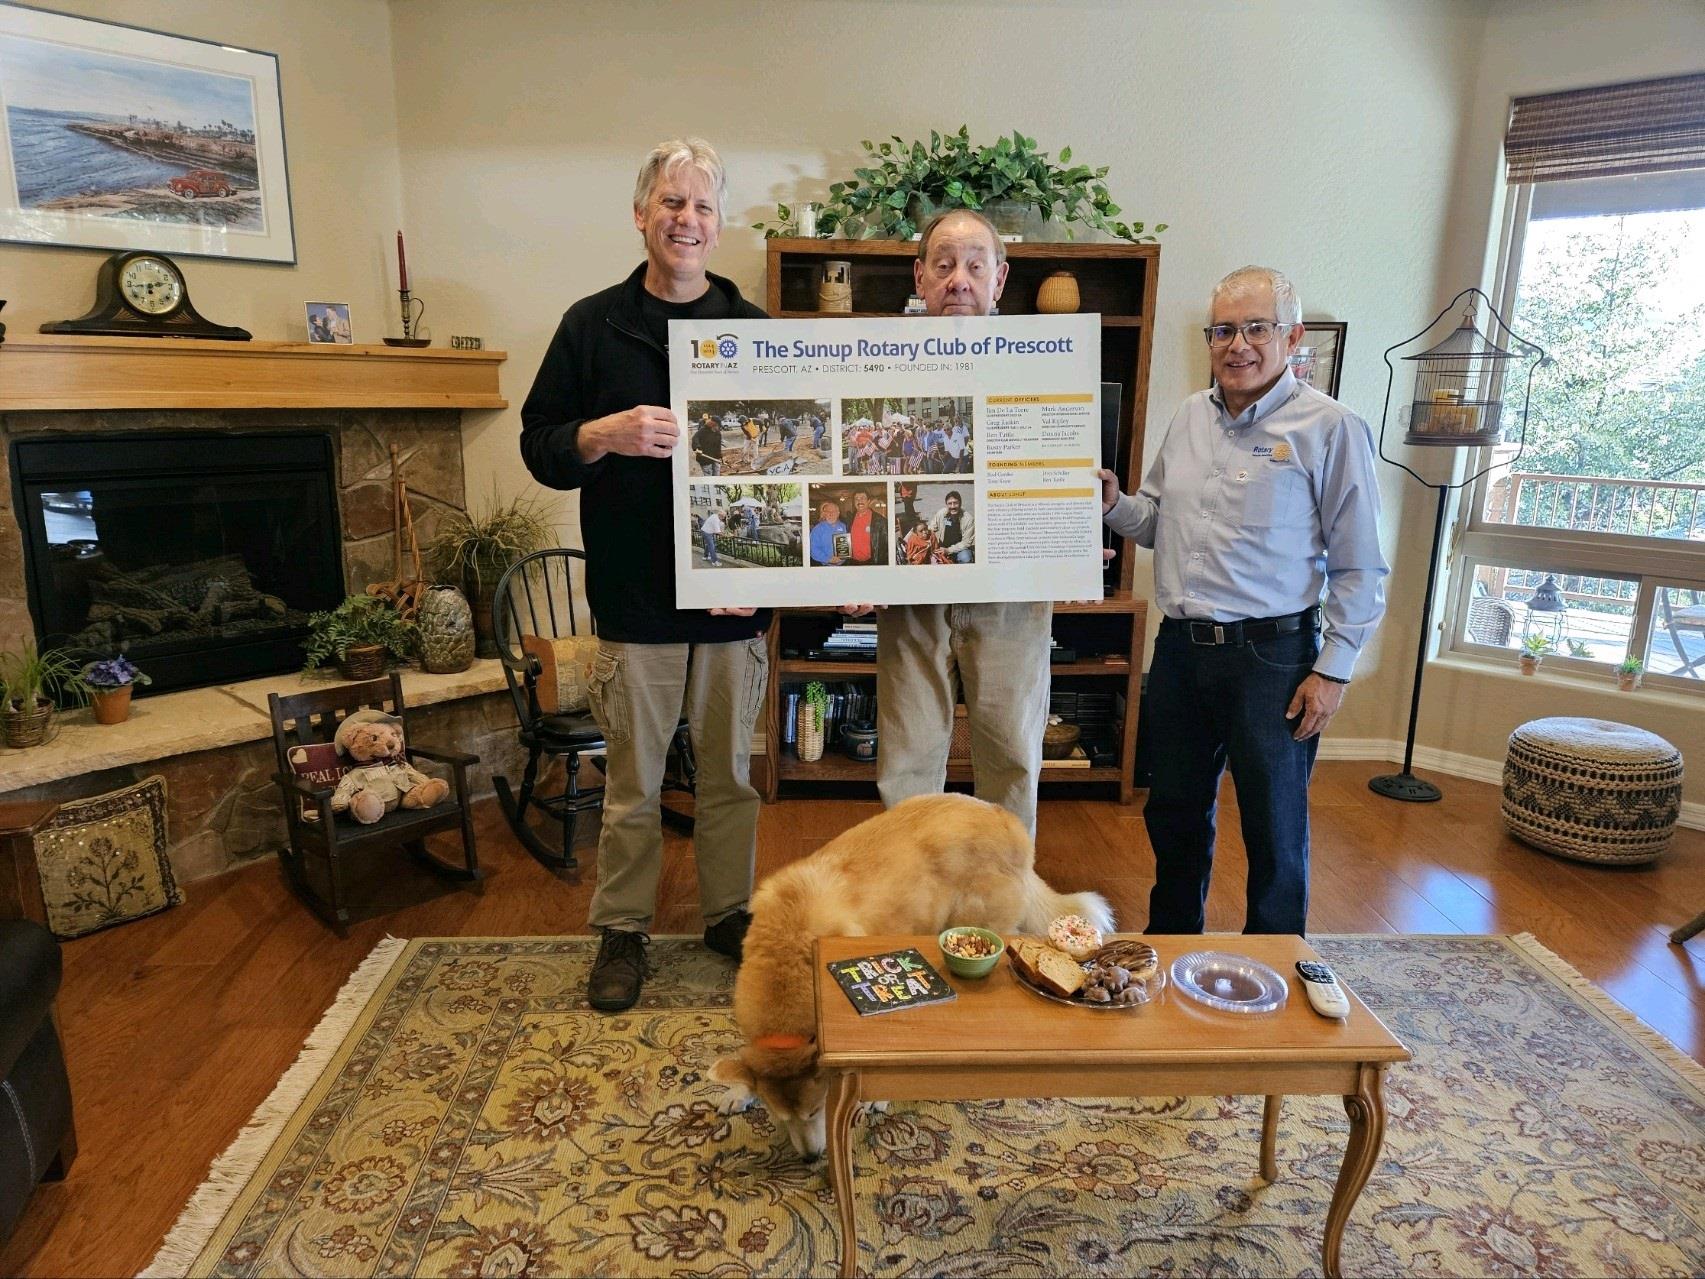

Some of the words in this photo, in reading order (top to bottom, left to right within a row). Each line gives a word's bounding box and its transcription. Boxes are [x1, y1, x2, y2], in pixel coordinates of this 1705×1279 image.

[752, 340, 789, 358] The
[793, 340, 852, 362] Sunup
[857, 339, 919, 362] Rotary
[924, 338, 966, 356] Club
[971, 336, 992, 354] of
[996, 336, 1074, 354] Prescott
[801, 364, 812, 372] AZ
[822, 364, 862, 373] DISTRICT:
[864, 364, 885, 372] 5490
[894, 363, 938, 372] FOUNDED
[940, 362, 952, 371] IN:
[955, 362, 974, 371] 1981
[1253, 446, 1274, 454] Rotary
[840, 957, 923, 984] TRICK
[878, 974, 900, 985] OR
[851, 970, 932, 1002] TREAT
